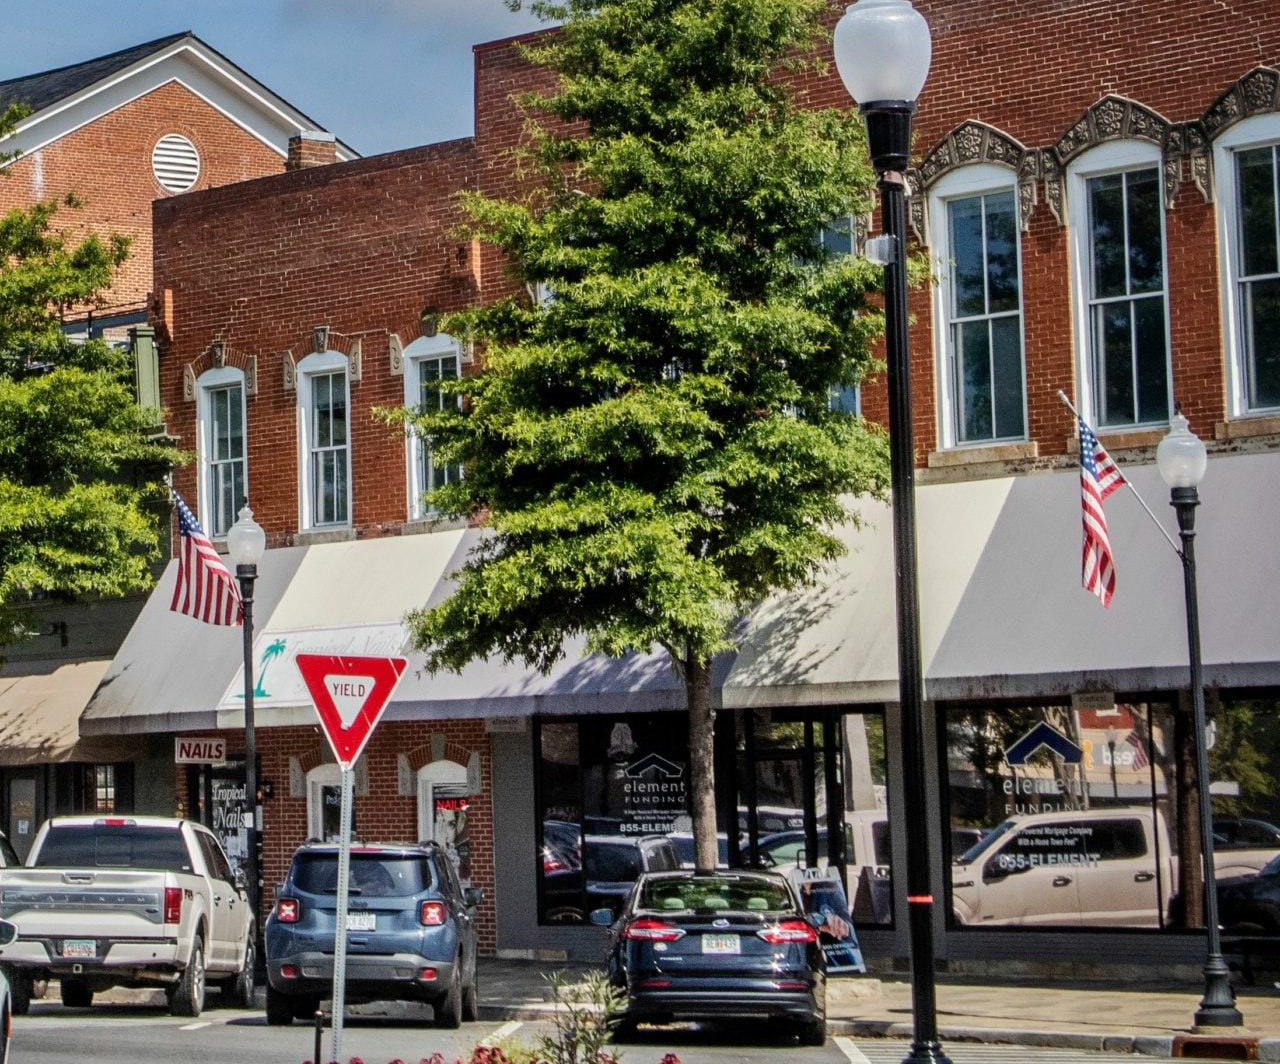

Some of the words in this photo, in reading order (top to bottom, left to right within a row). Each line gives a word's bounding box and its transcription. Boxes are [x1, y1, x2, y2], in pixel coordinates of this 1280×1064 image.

[333, 683, 365, 697] YIELD
[179, 742, 223, 759] NAILS
[624, 780, 686, 793] element
[212, 783, 247, 807] Tropical
[624, 796, 685, 804] FUNDING
[436, 799, 469, 811] NAILS
[999, 853, 1101, 868] 855-ELEMENT
